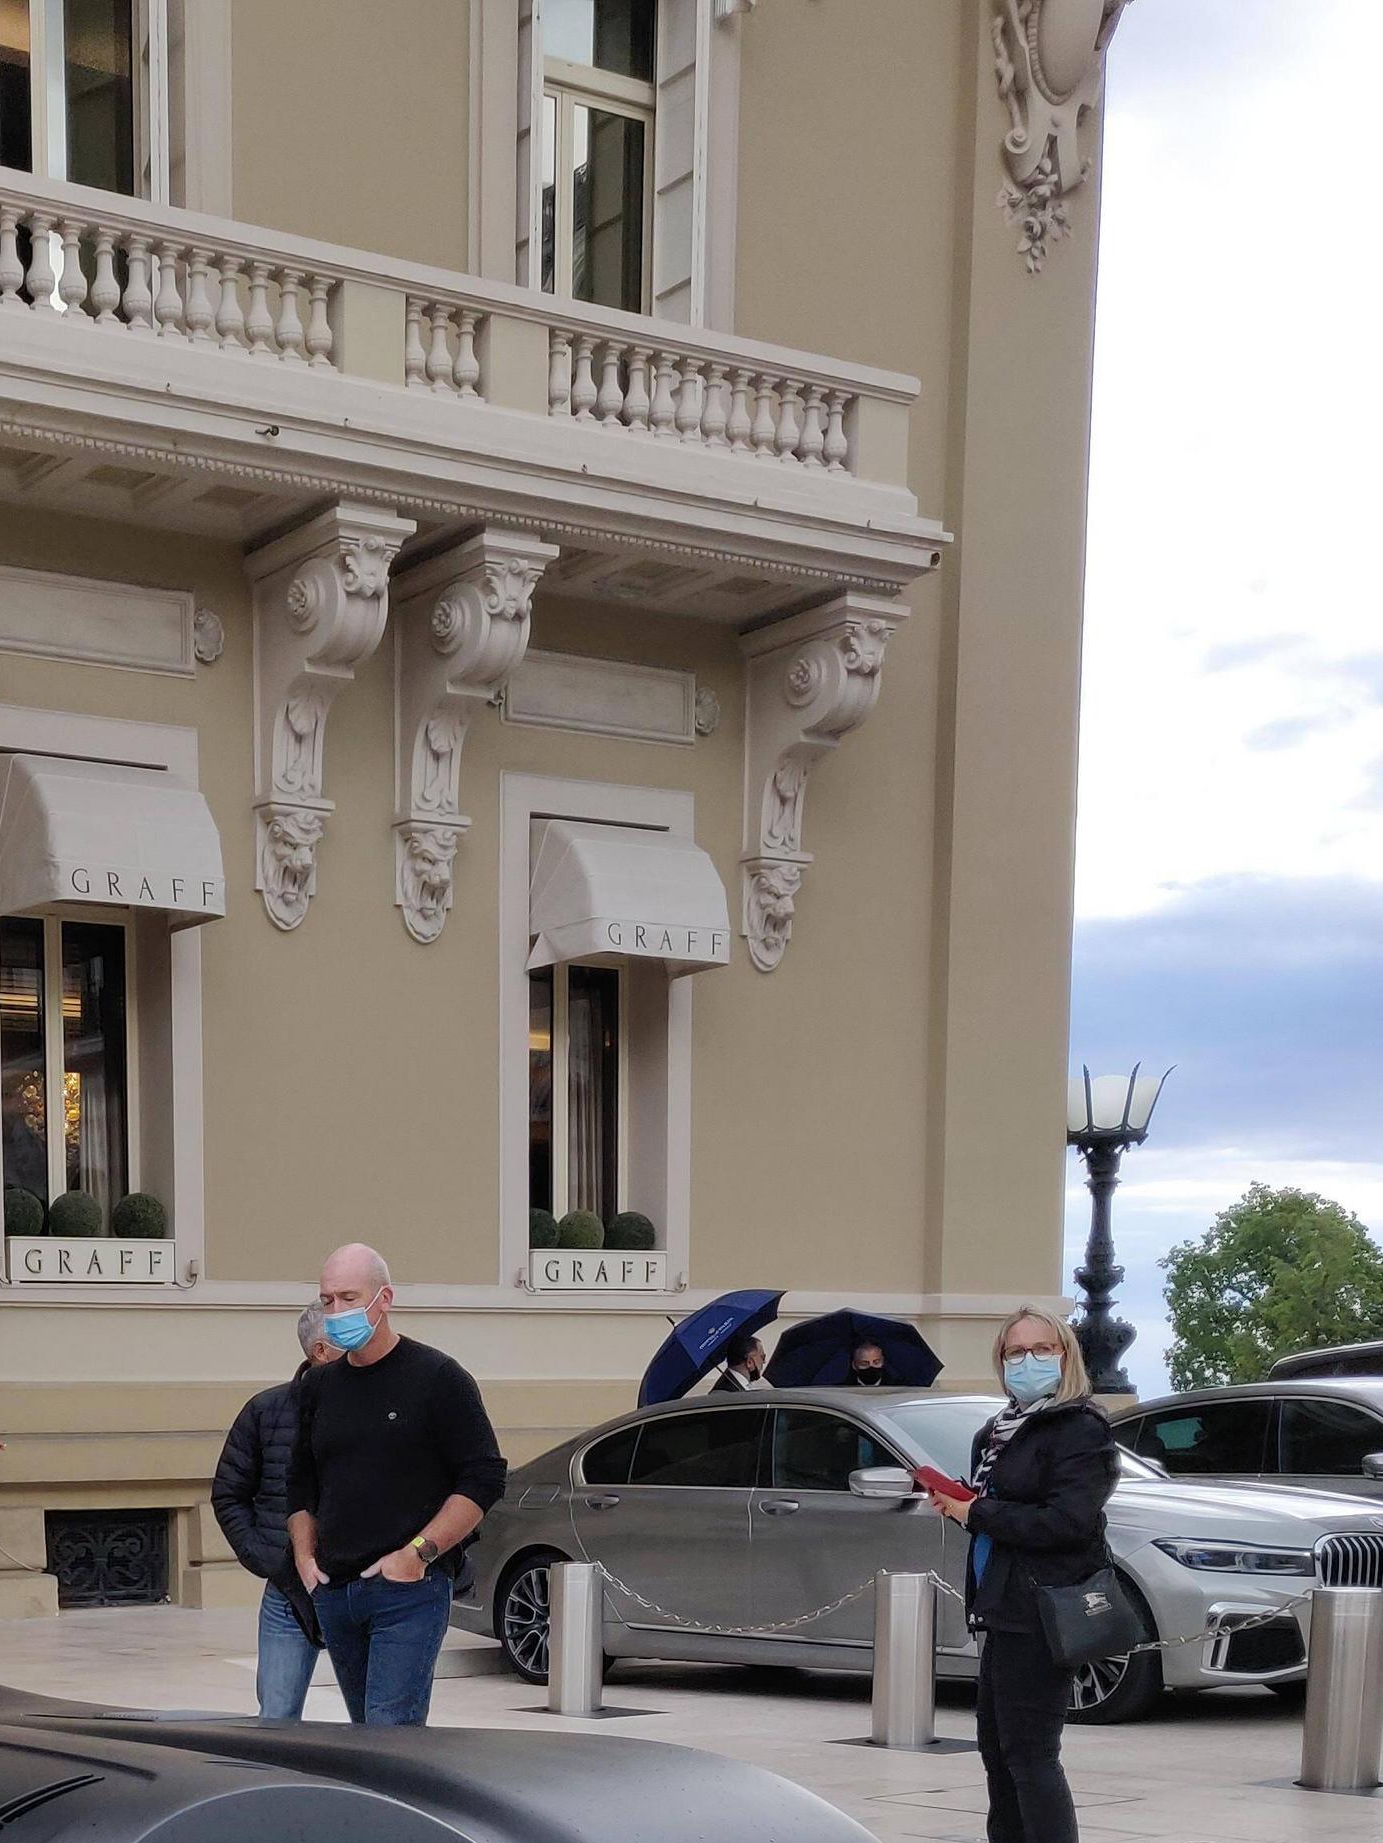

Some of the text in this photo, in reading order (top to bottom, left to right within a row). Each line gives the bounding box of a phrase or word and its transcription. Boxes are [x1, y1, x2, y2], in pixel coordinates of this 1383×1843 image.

[71, 868, 215, 906] GRAFF
[608, 923, 723, 955] GRAFF
[25, 1249, 162, 1275] GRAFF
[545, 1260, 658, 1283] GRAFF
